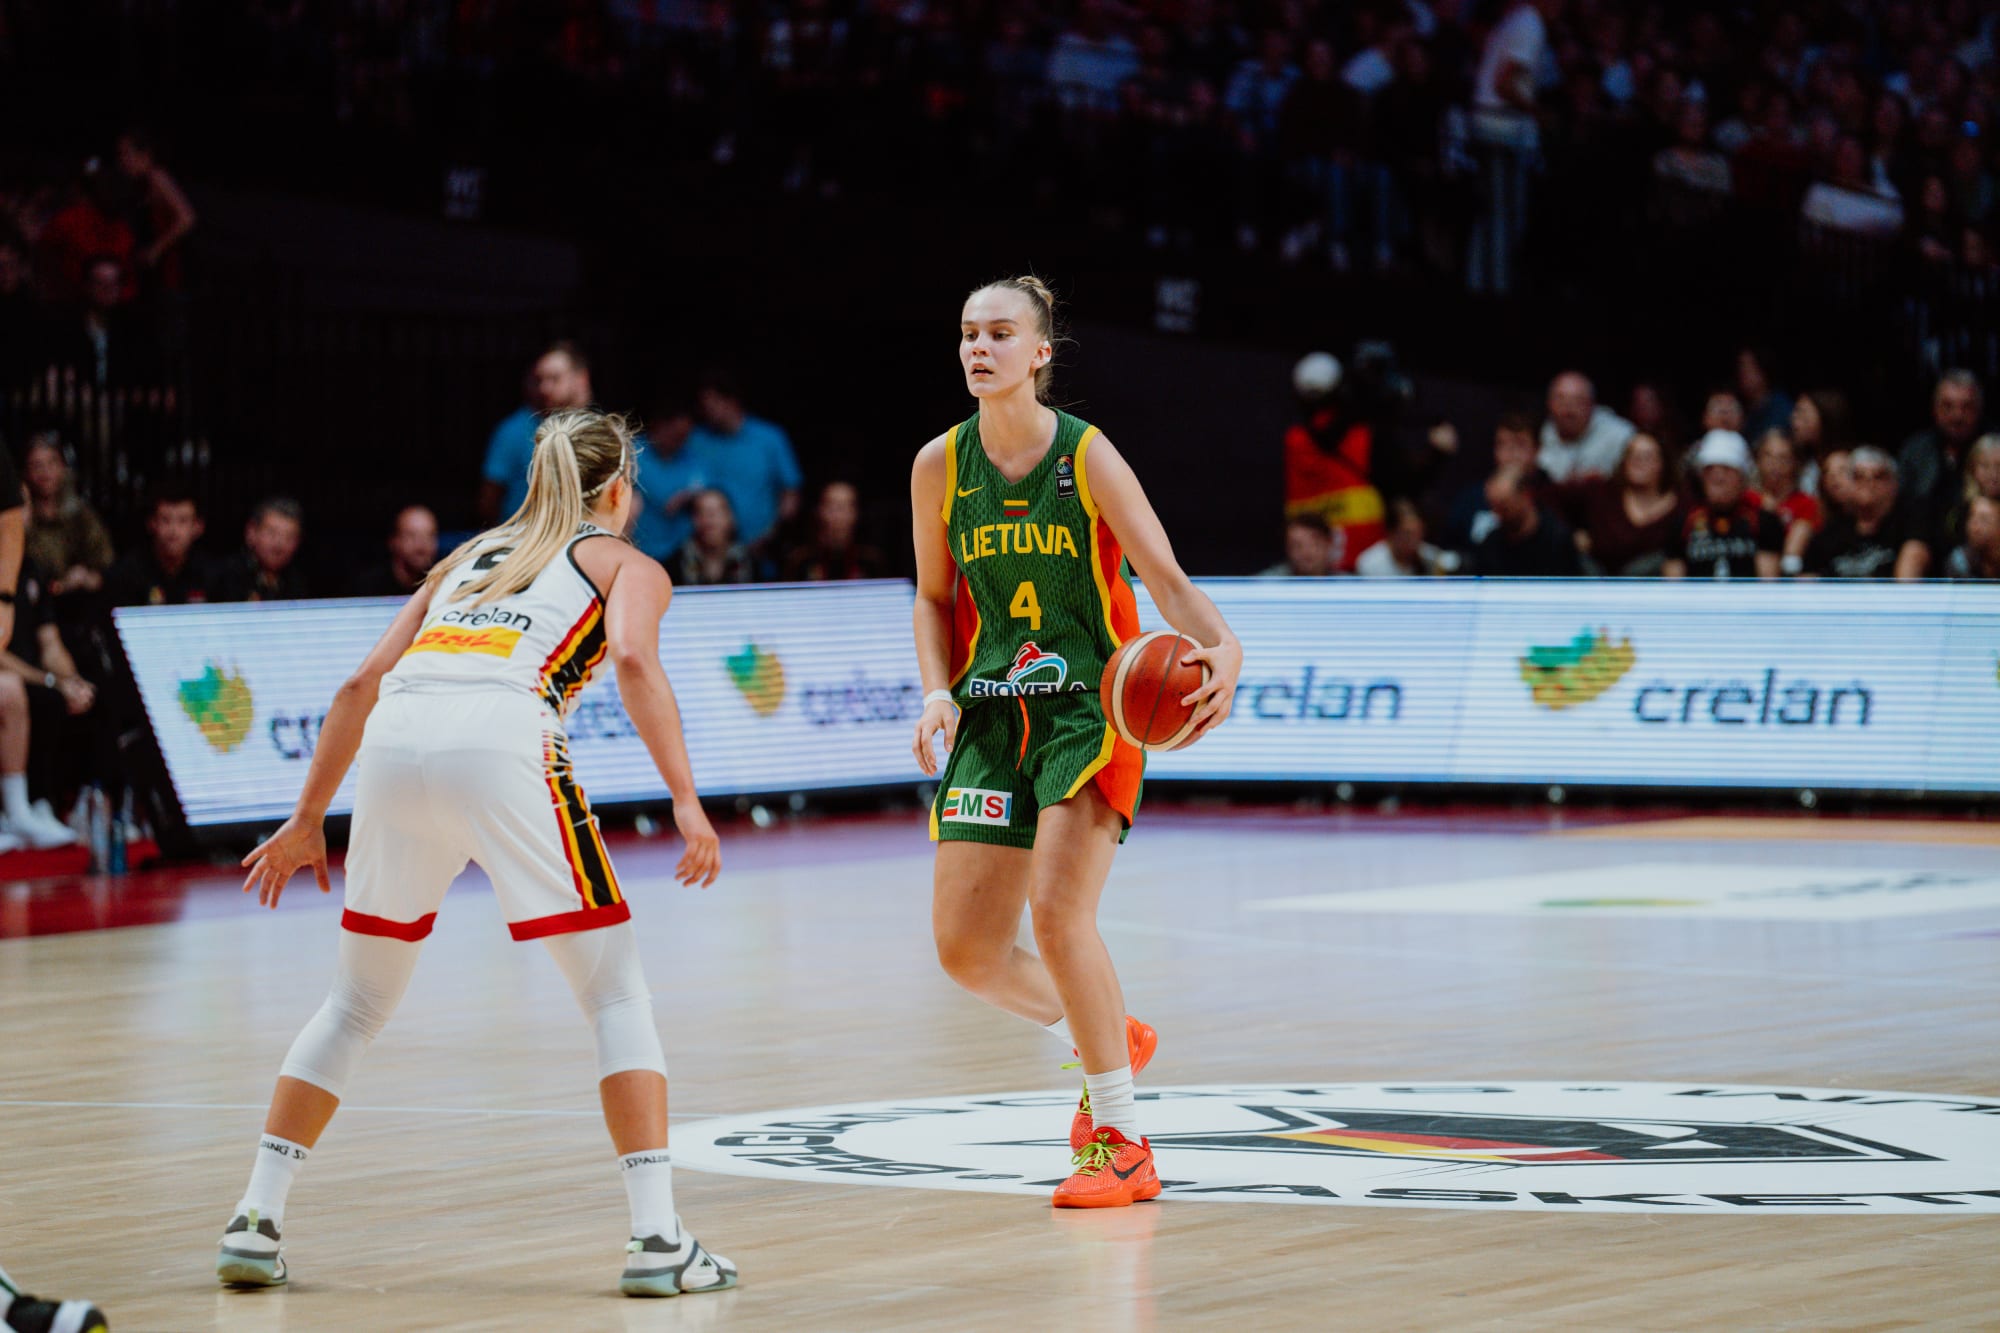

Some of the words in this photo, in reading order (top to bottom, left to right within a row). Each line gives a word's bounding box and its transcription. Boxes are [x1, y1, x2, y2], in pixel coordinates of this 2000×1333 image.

[960, 523, 1078, 563] LIETUVA
[442, 607, 532, 631] crelan
[1009, 581, 1041, 630] 4
[1231, 665, 1403, 720] relan
[1632, 667, 1875, 725] crelan
[1021, 1176, 2000, 1206] ASKET
